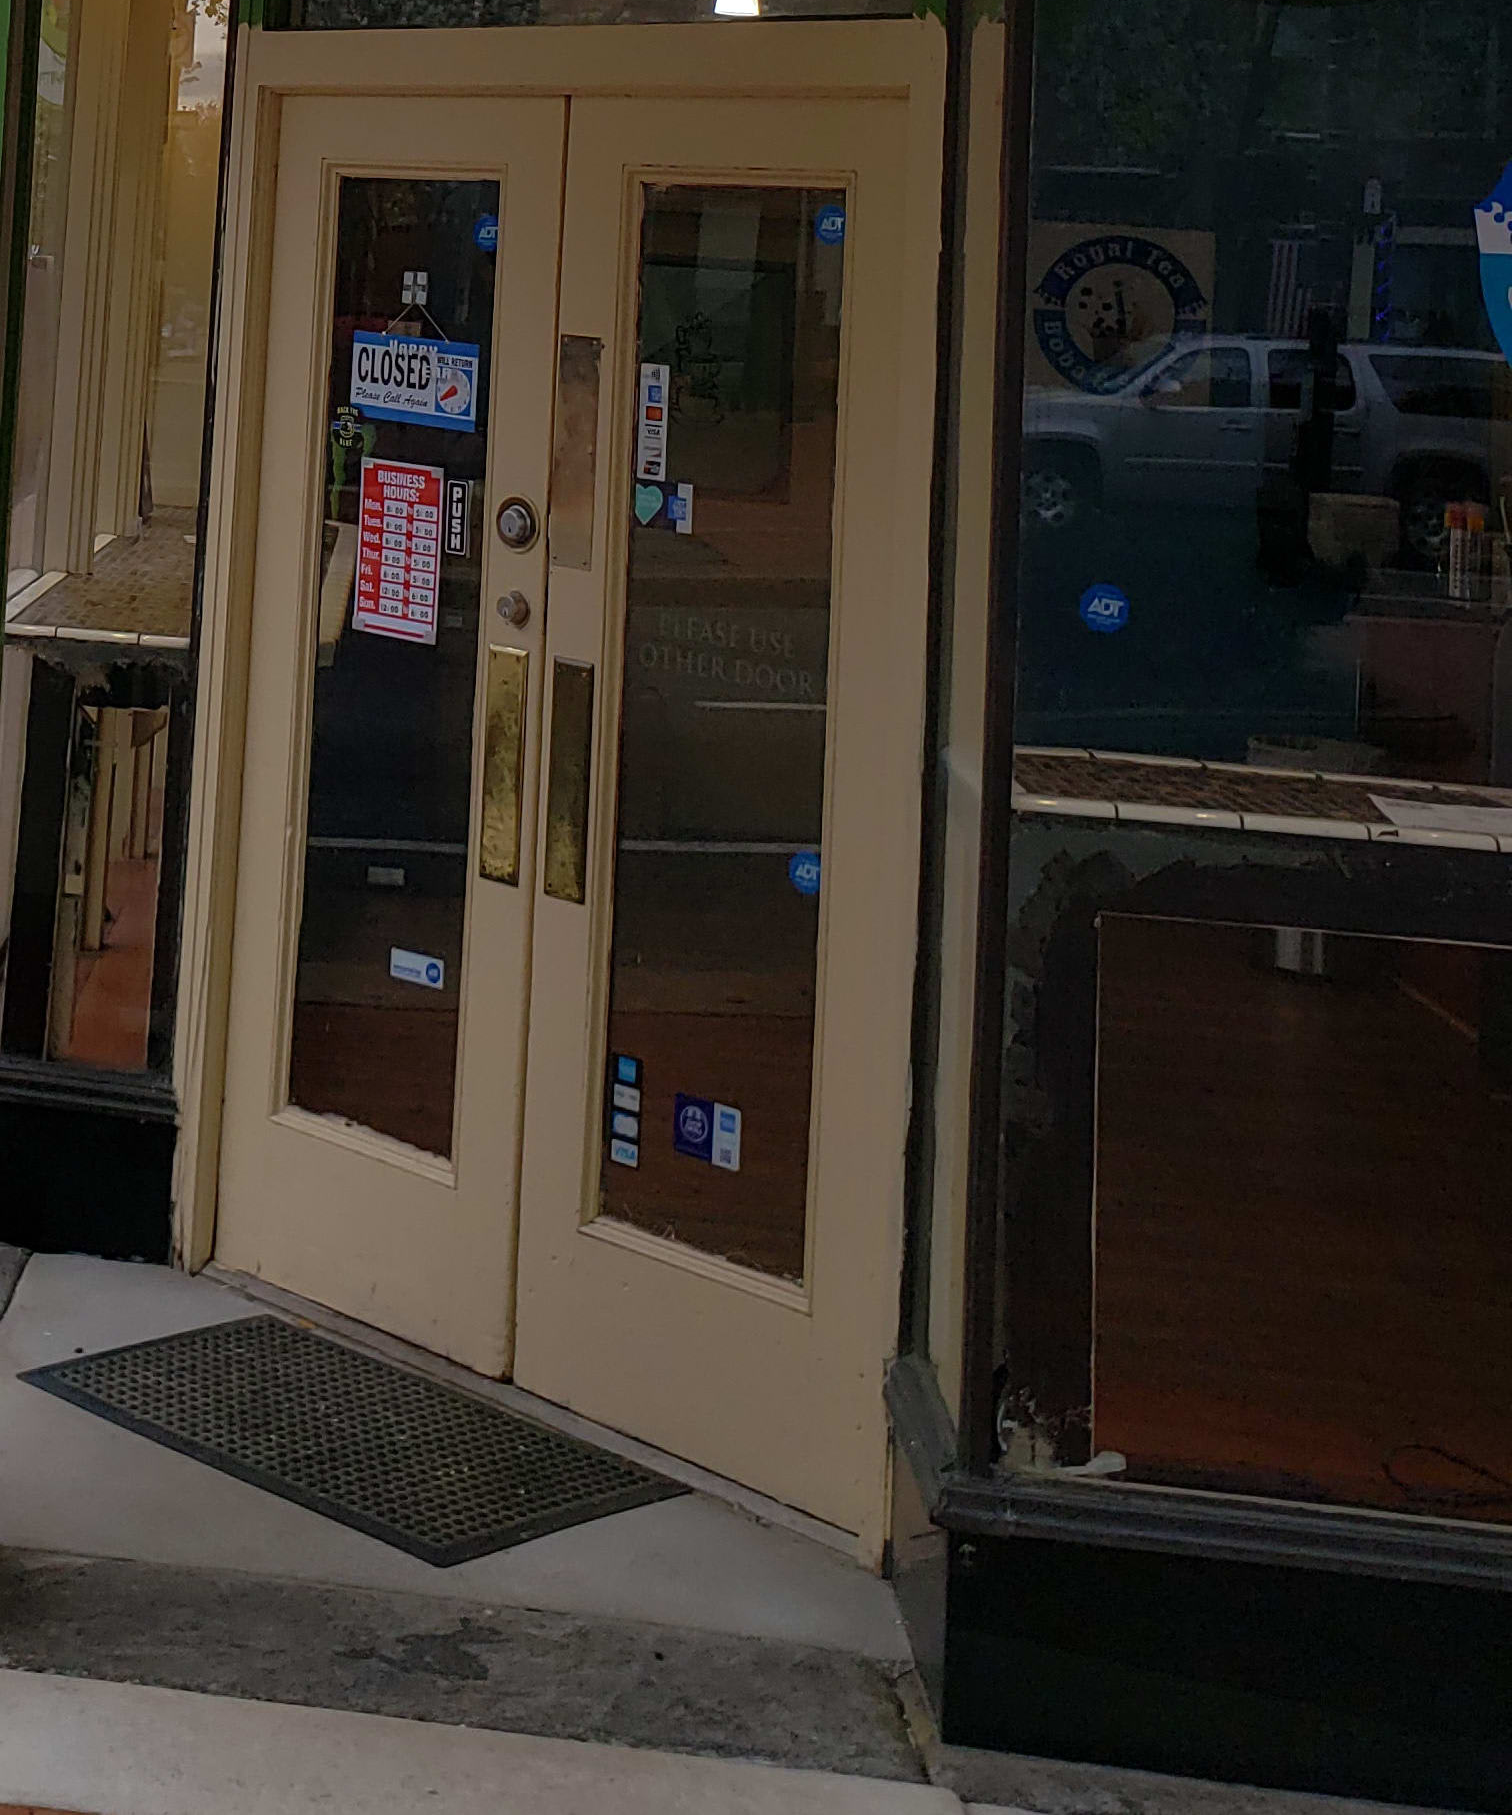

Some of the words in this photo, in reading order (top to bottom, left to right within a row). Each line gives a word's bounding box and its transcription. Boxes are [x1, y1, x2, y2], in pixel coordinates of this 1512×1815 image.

[478, 225, 498, 240] ADT
[820, 216, 845, 233] ADT
[1054, 241, 1135, 281] Royal
[357, 346, 431, 391] CLOSED
[355, 386, 381, 402] Please
[383, 390, 402, 405] Call
[403, 394, 428, 409] Again
[377, 469, 426, 489] BUSINESS
[382, 484, 420, 503] HOURS:
[450, 486, 463, 551] PUSH
[1087, 597, 1125, 618] ADT
[794, 864, 820, 881] ADT
